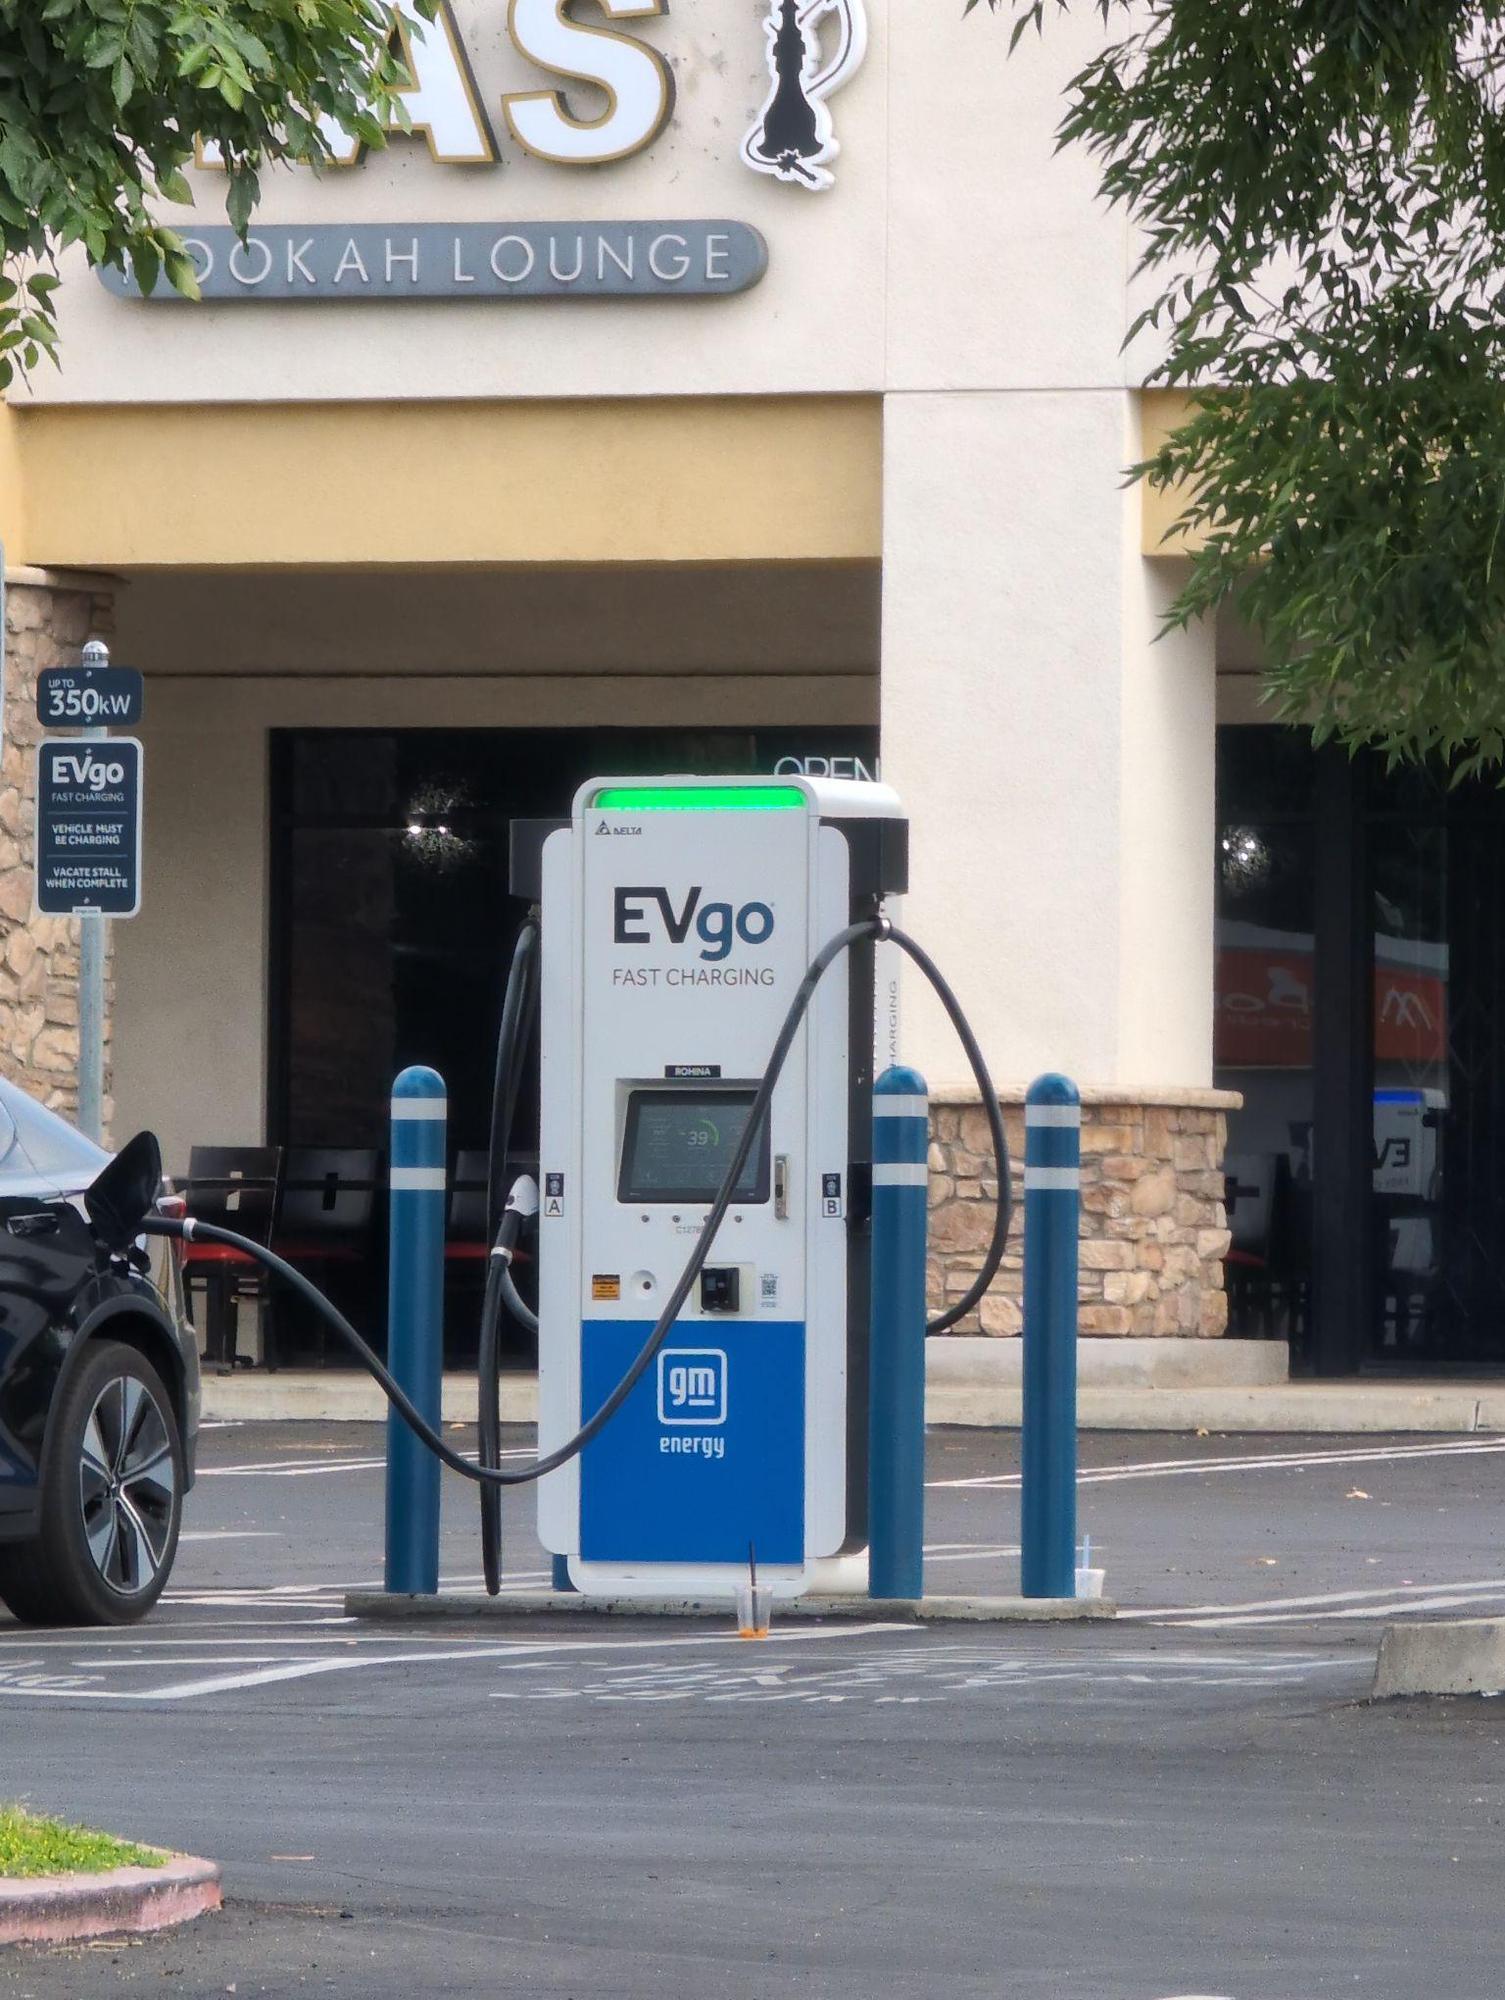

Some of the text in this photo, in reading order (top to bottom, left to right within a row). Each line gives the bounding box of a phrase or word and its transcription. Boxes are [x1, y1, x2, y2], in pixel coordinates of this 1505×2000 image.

[195, 0, 672, 169] AS
[122, 234, 731, 286] OOKAH LOUNGE
[48, 679, 75, 688] UP TO
[49, 688, 131, 716] 350kW
[51, 756, 125, 791] EVgo
[52, 792, 125, 802] FAST CHARGING
[51, 823, 124, 834] VEHICLE MUST
[55, 835, 121, 845] BE CHARGING
[53, 866, 121, 877] VACATE STALL
[45, 878, 128, 889] WHEN COMPLETE
[614, 886, 774, 962] EVgo
[613, 968, 774, 986] FAST CHARGING
[688, 1131, 709, 1146] 39
[549, 1199, 560, 1214] A
[828, 1200, 838, 1215] B
[669, 1367, 716, 1406] gm
[660, 1437, 725, 1459] energy
